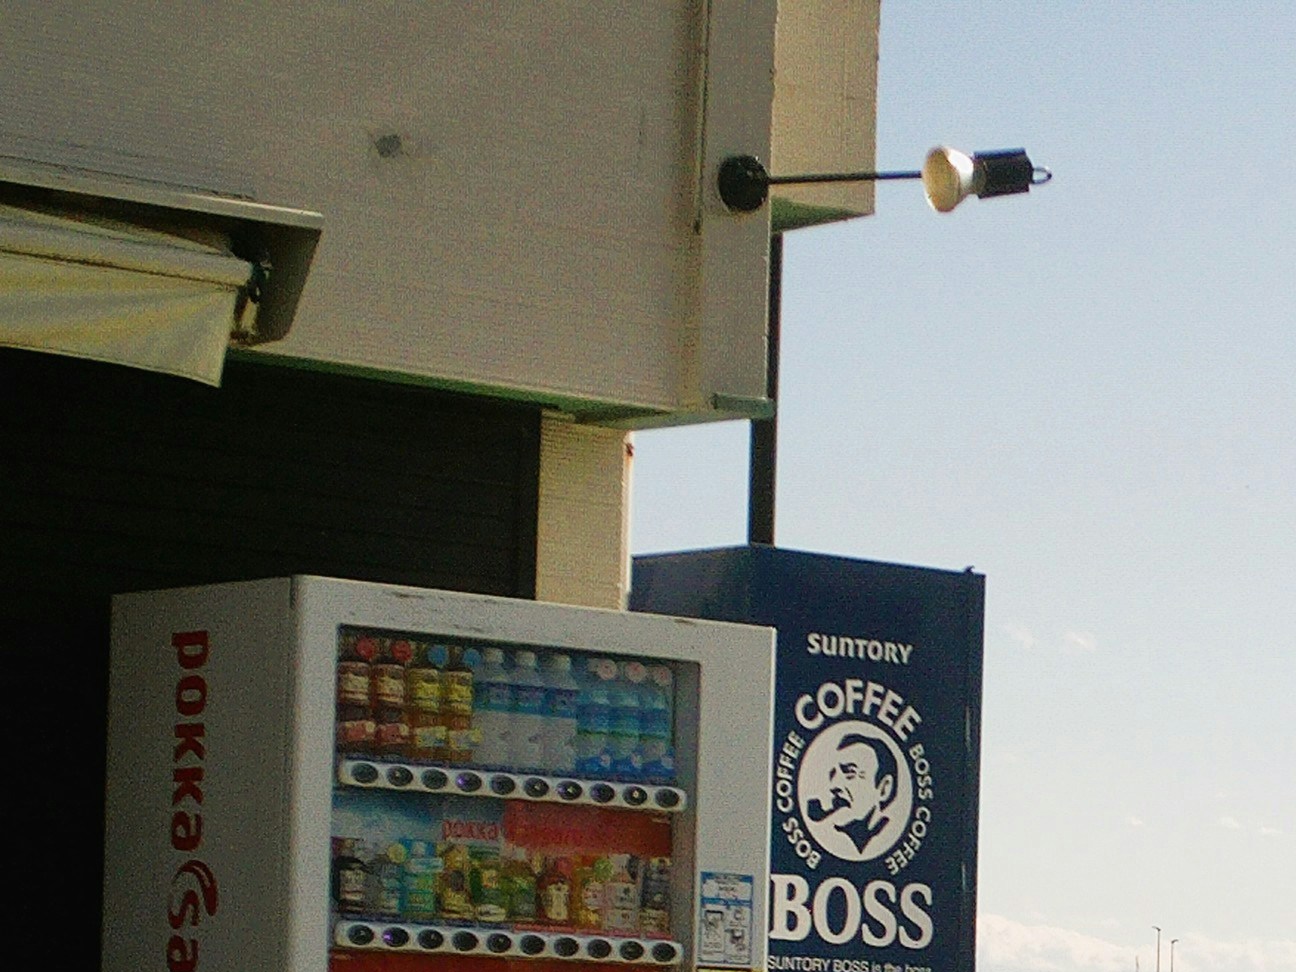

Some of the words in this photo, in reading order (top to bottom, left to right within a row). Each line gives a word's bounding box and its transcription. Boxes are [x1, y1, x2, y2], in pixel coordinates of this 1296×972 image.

[794, 678, 922, 742] COFFEE
[776, 731, 806, 813] COFFEE
[909, 743, 934, 800] BOSS
[782, 817, 822, 870] BOSS
[885, 806, 932, 875] COFFEE
[769, 873, 934, 949] BOSS
[768, 954, 830, 972] SUNTORY
